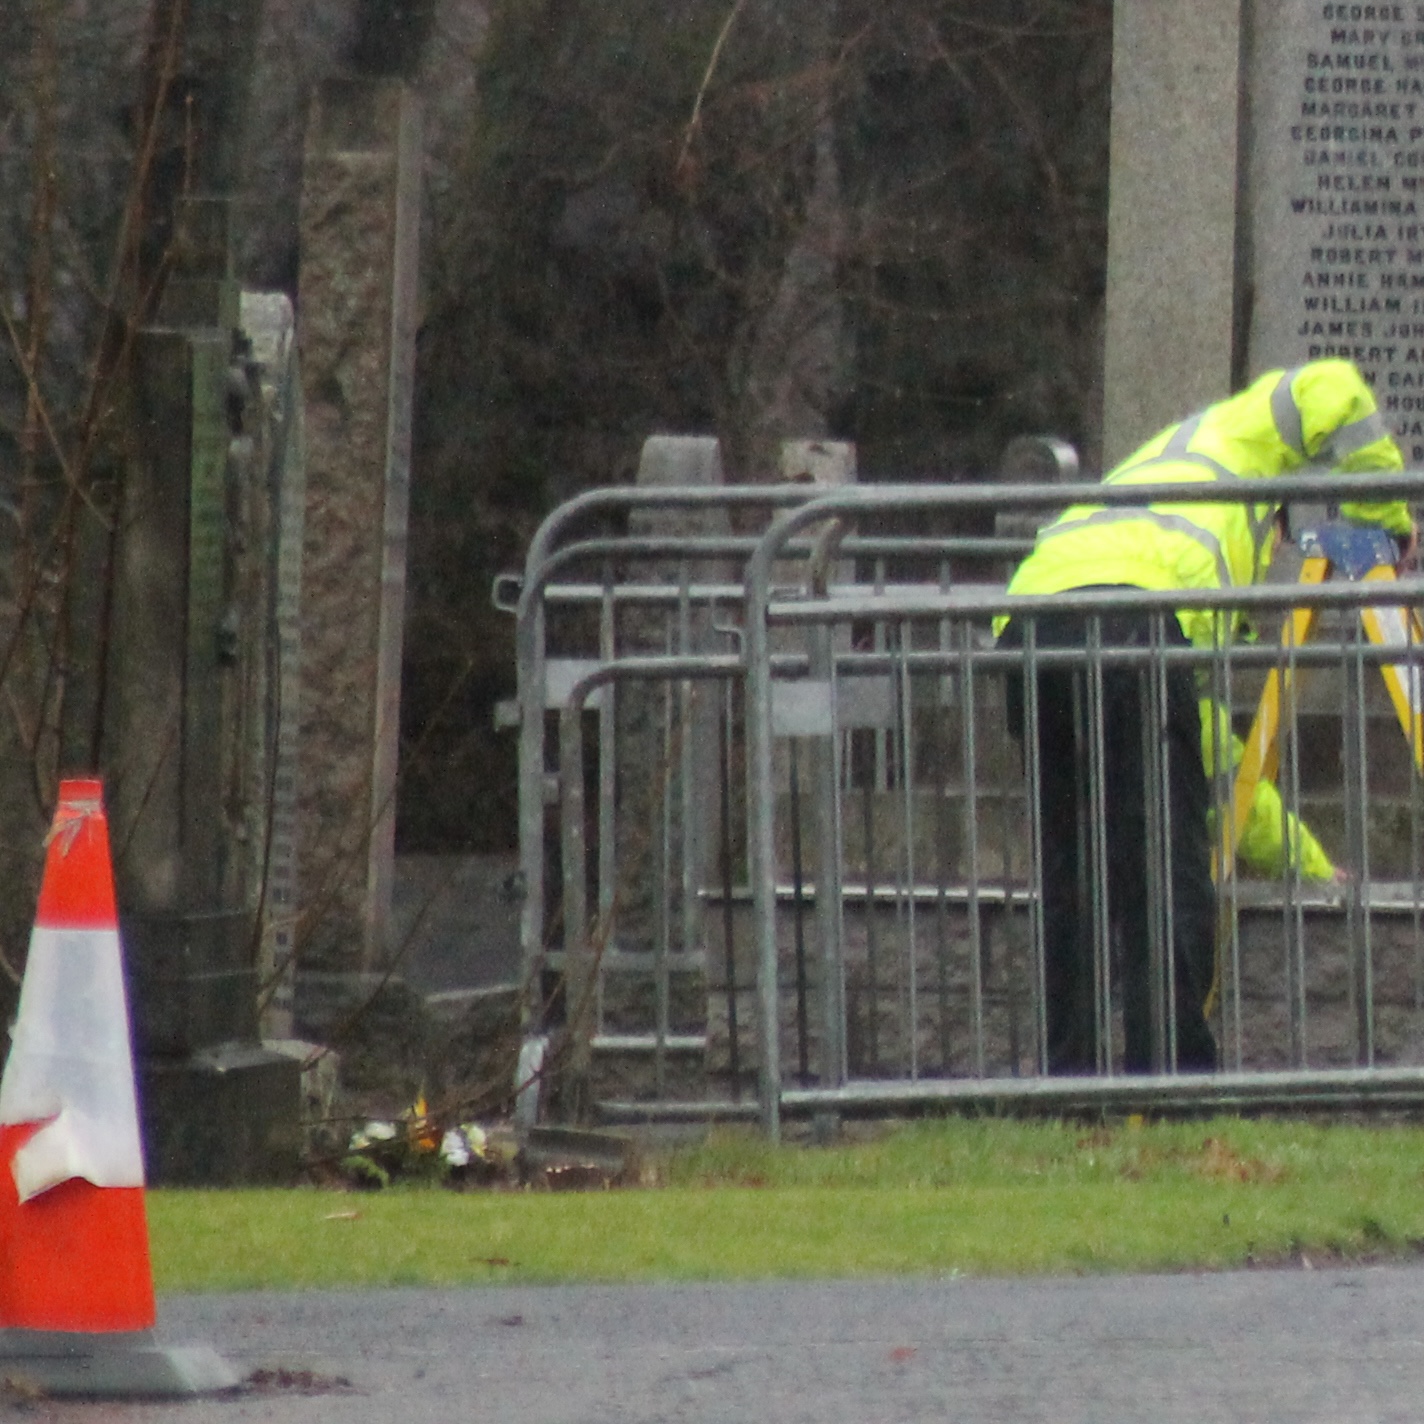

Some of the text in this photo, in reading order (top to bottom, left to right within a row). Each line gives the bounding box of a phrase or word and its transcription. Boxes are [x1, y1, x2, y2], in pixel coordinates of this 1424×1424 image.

[1322, 4, 1403, 22] GEORGE
[1330, 29, 1390, 45] MARY
[1306, 53, 1391, 70] SAMUEL
[1304, 77, 1385, 94] GEORGE
[1301, 102, 1416, 119] MARGARET
[1290, 125, 1398, 142] GEORGINA
[1303, 150, 1380, 166] DANIEL
[1318, 174, 1390, 191] HELEN
[1290, 197, 1416, 215] WILLIAMINA
[1322, 224, 1387, 241] JULIA
[1310, 247, 1396, 264] ROBERT
[1302, 271, 1368, 289] ANNIE
[1304, 296, 1401, 313] WILLIAM
[1297, 321, 1373, 337] JAMES
[1308, 345, 1397, 363] ROBERT
